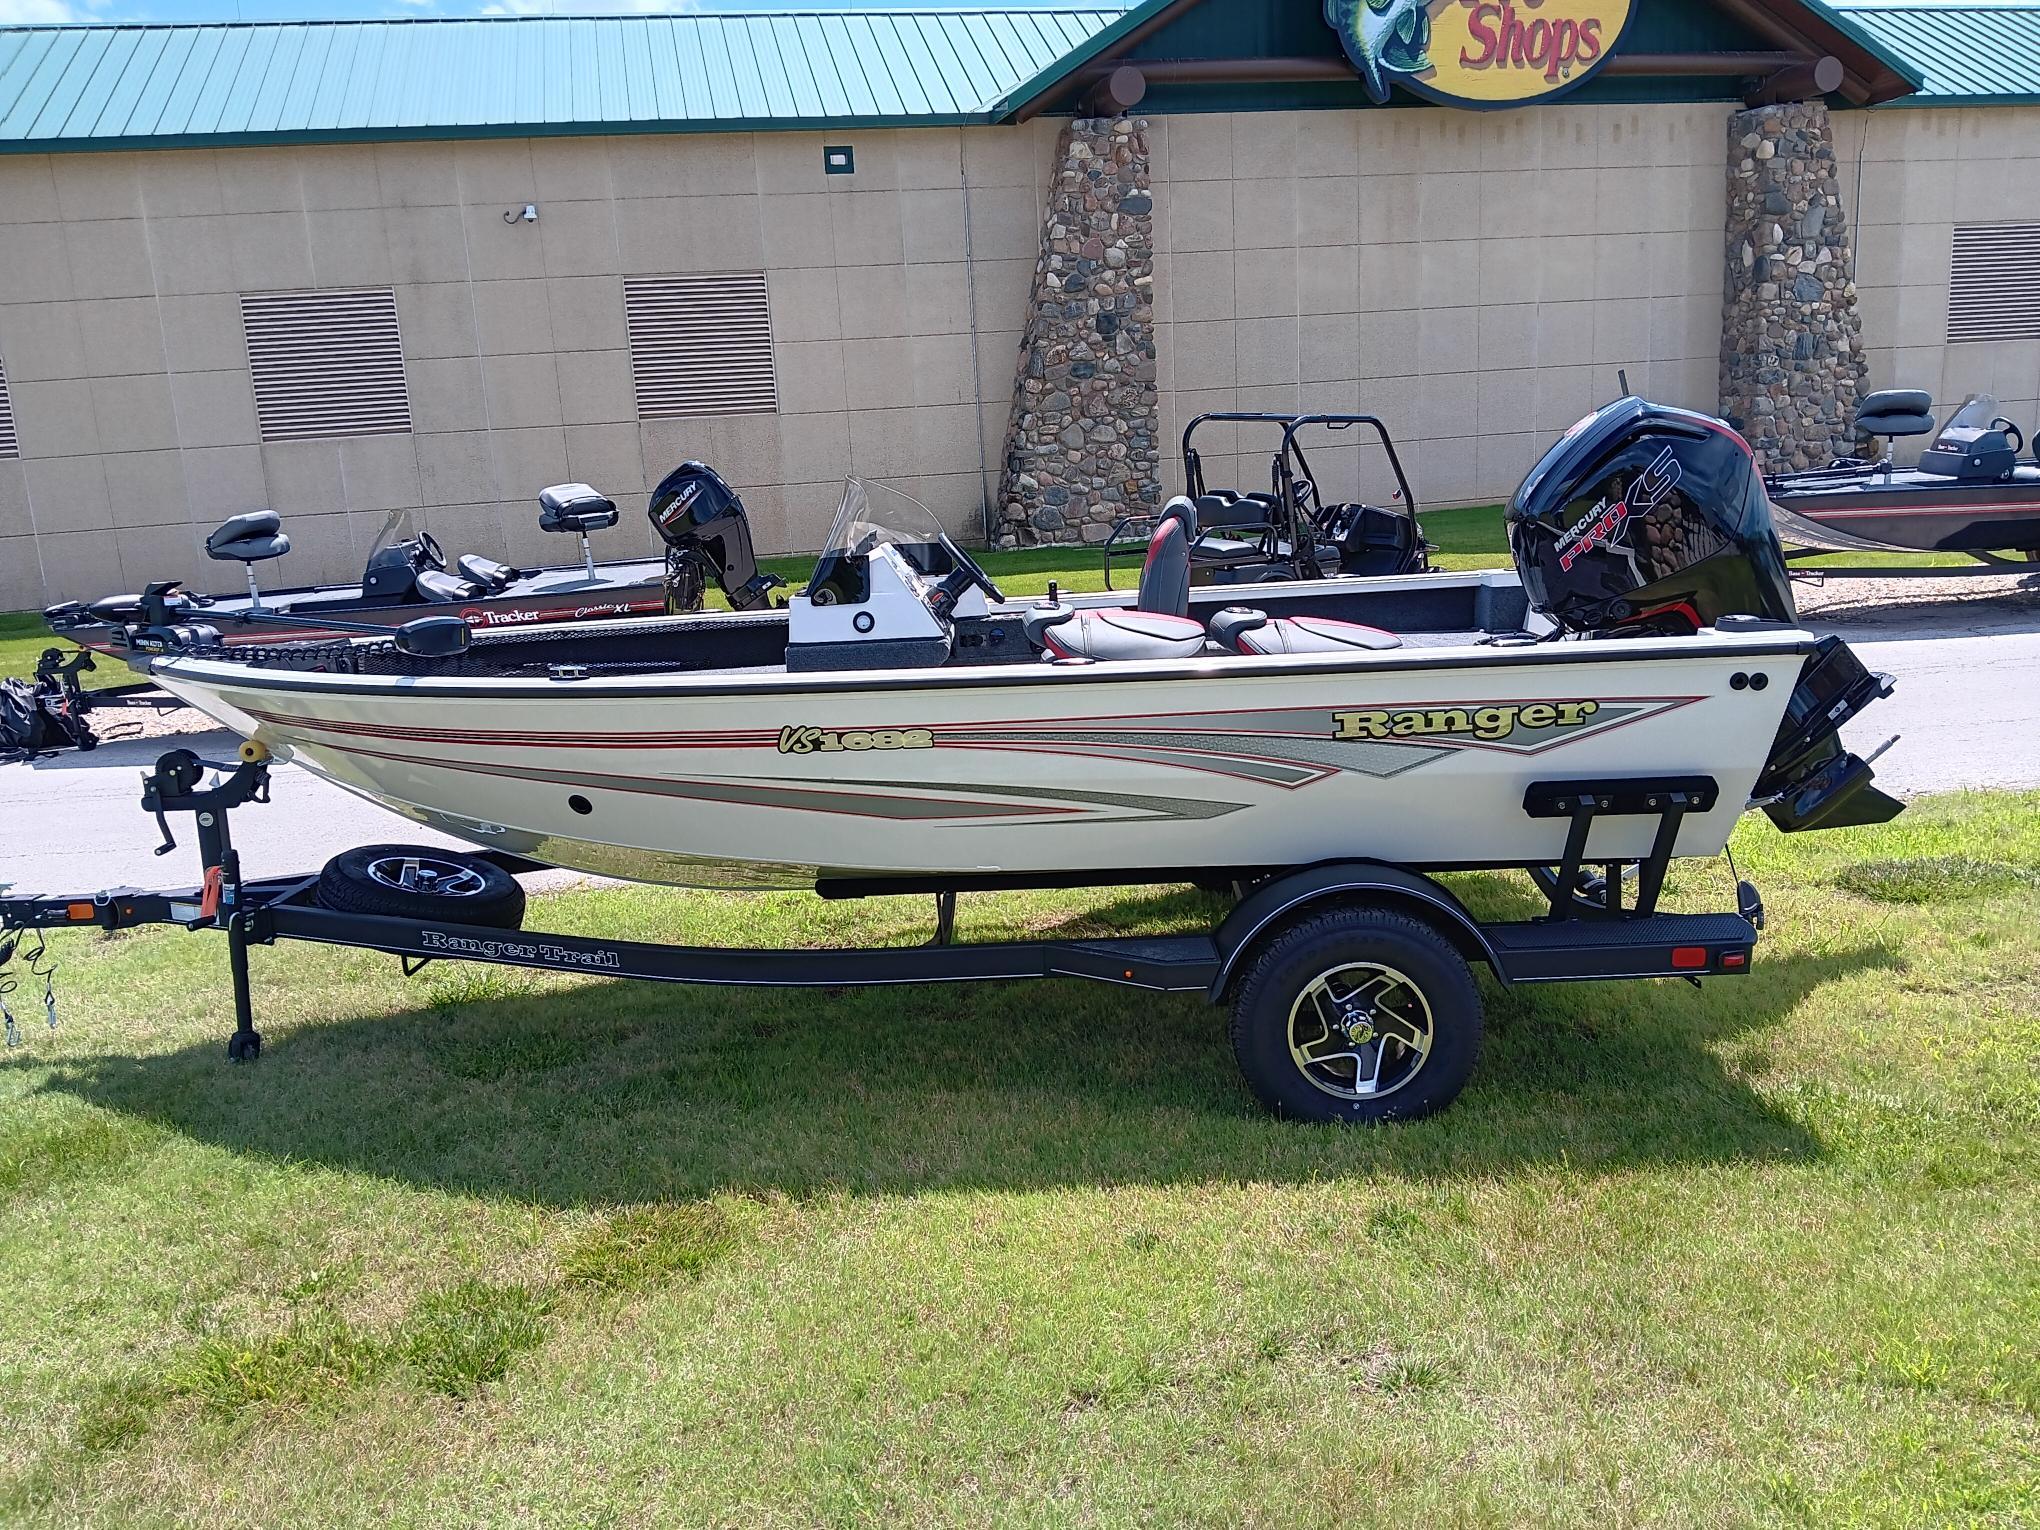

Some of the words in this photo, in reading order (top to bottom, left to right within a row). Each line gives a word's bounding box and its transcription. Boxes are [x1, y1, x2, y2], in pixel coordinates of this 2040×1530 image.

[1459, 0, 1602, 82] Shops
[659, 480, 697, 523] MERCURY
[1559, 500, 1628, 573] PRO
[1610, 444, 1683, 549] XS
[1553, 496, 1608, 552] MERCURY
[483, 610, 540, 624] Tracker
[574, 603, 616, 618] Classic
[613, 603, 632, 613] XL
[1333, 699, 1600, 740] Ranger
[421, 931, 537, 957] Ranger
[539, 944, 621, 968] Trail
